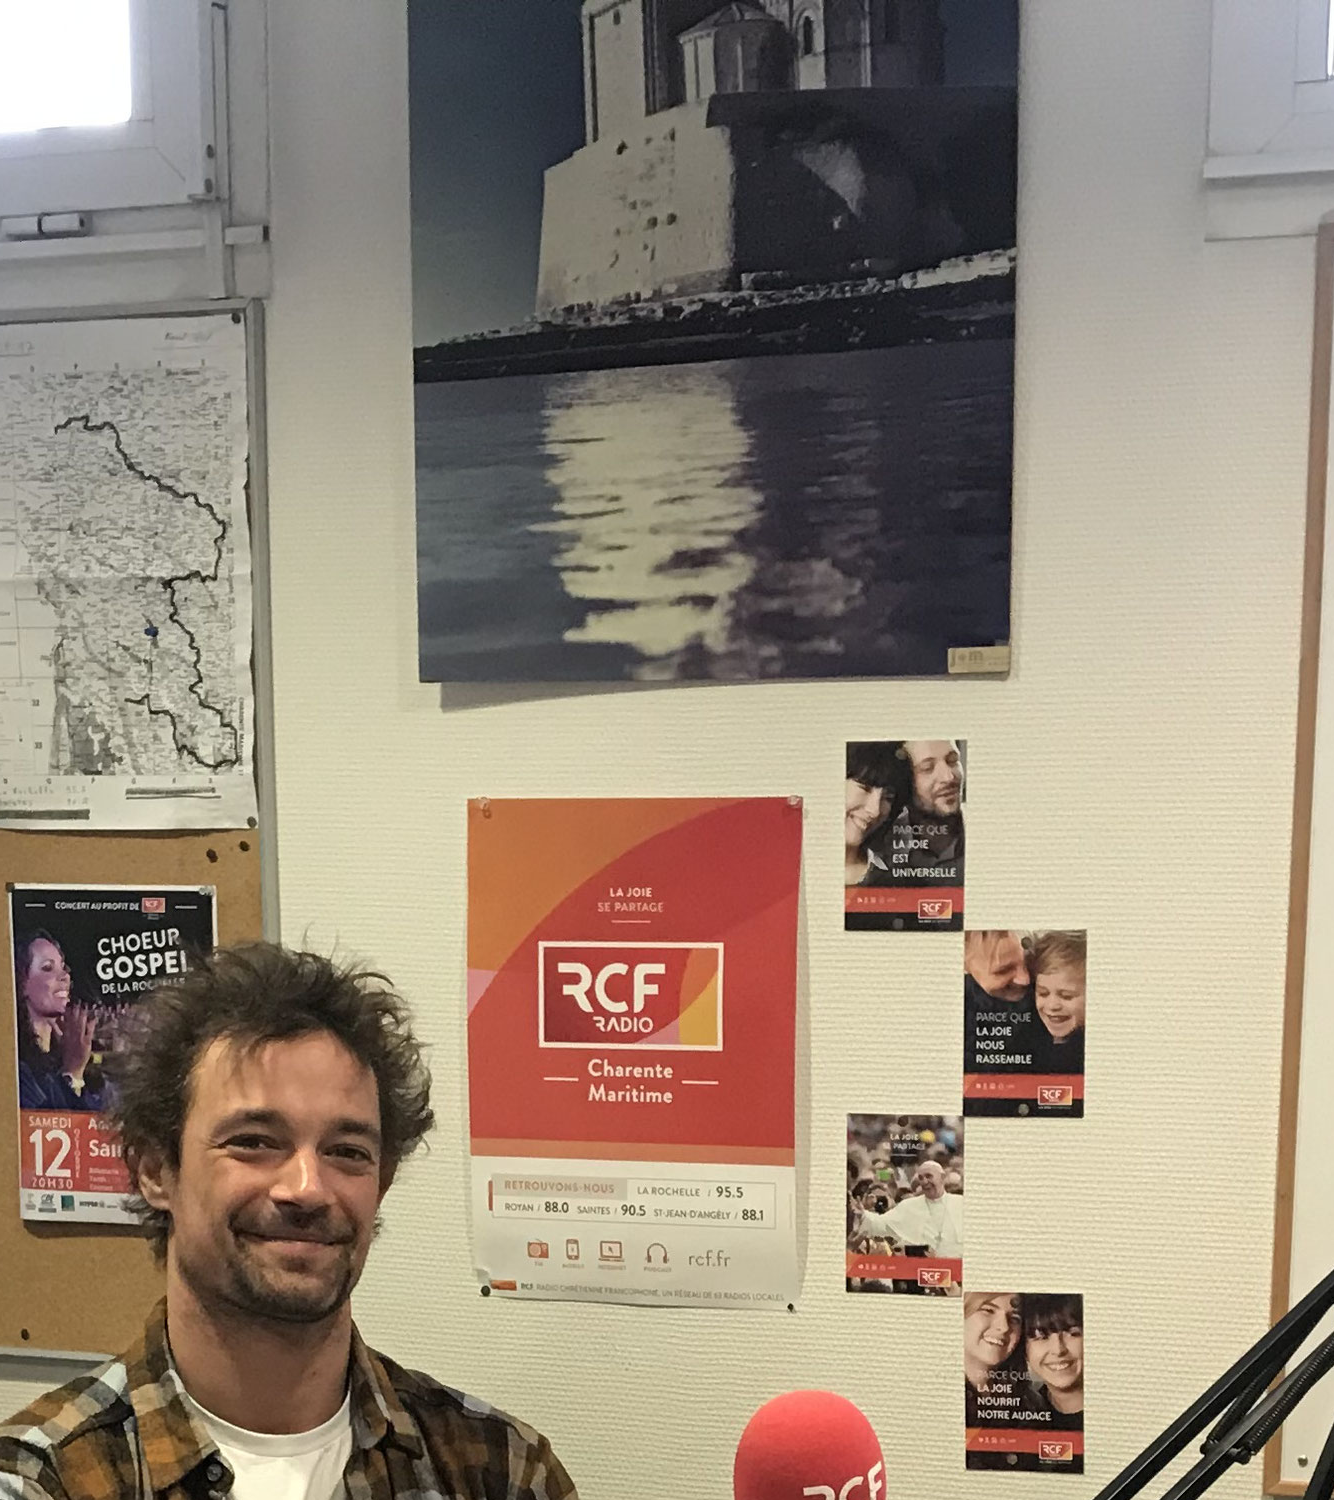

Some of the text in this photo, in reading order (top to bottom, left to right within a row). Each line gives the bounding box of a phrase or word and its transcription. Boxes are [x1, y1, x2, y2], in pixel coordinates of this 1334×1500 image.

[893, 825, 948, 836] PARCE QUE
[893, 840, 929, 849] LA JOIE
[893, 854, 909, 863] EST
[892, 868, 957, 877] UNIVERSELLE
[610, 887, 652, 897] LA JOIE
[55, 902, 90, 910] CONCERT
[91, 902, 101, 910] AU
[102, 902, 128, 910] PROFIT
[129, 903, 140, 911] DE
[597, 902, 664, 913] SE PARTAGE
[922, 903, 942, 914] RCF
[97, 928, 180, 956] CHOEUR
[102, 983, 116, 994] DE
[117, 983, 131, 993] LA
[557, 962, 666, 1014] RCF
[976, 1012, 1031, 1024] PARCE QUE
[592, 1016, 654, 1033] RADIO
[976, 1027, 1012, 1036] LA JOIE
[976, 1041, 1005, 1050] NOUS
[976, 1055, 1032, 1064] RASSEMBLE
[587, 1058, 674, 1079] Charente
[587, 1084, 673, 1104] Maritime
[1042, 1090, 1062, 1099] RCF
[29, 1116, 71, 1128] SAMEDI
[29, 1129, 71, 1177] 12
[32, 1178, 73, 1189] 20H30
[637, 1186, 649, 1195] LA
[652, 1187, 700, 1197] ROCHELLE
[716, 1186, 744, 1198] 95.5
[504, 1202, 534, 1212] ROYAN
[544, 1201, 569, 1213] 88.0
[577, 1205, 611, 1215] SAINTES
[621, 1204, 646, 1216] 90.5
[742, 1209, 764, 1221] 88.1
[688, 1250, 731, 1267] rcf.fr
[921, 1271, 941, 1281] RCF
[537, 1283, 558, 1291] RADIO
[703, 1291, 712, 1299] DE
[724, 1292, 751, 1300] RADIOS
[1010, 1371, 1030, 1381] QUE
[977, 1384, 1012, 1393] LA JOIE
[977, 1397, 1021, 1406] NOURRIT
[977, 1410, 1052, 1421] NOTRE AUDACE
[1043, 1445, 1063, 1454] RCF
